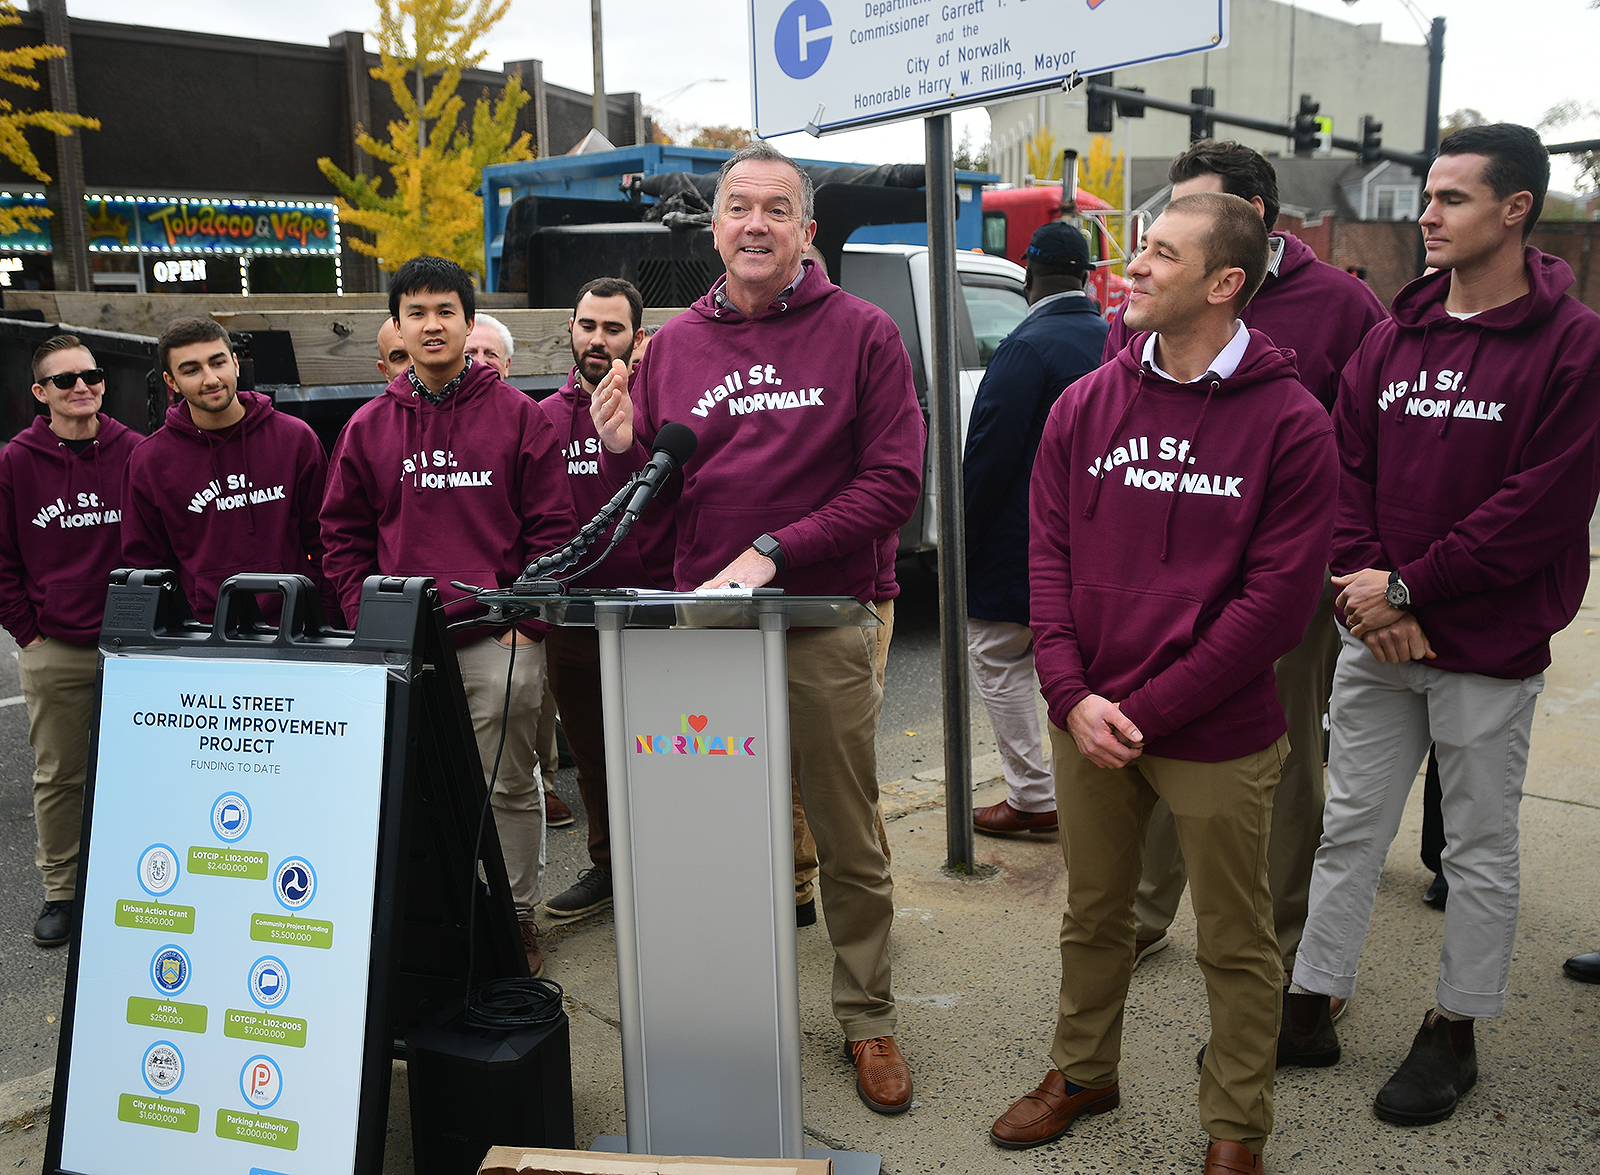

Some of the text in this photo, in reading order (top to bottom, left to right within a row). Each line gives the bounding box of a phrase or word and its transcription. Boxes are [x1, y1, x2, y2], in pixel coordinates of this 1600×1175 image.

[850, 0, 984, 45] Commissioner Garrett
[936, 24, 979, 44] and the
[907, 37, 1011, 75] City of Norwalk
[854, 83, 911, 109] Honorable
[918, 77, 951, 96] Harry
[960, 69, 973, 86] W.
[1034, 50, 1076, 71] Mayor
[147, 204, 255, 247] Tobacco
[153, 259, 207, 283] OPEN
[690, 363, 783, 418] Wall St.
[728, 387, 825, 416] NORWALK
[1123, 466, 1244, 498] NORWALK
[216, 485, 286, 511] NORWALK
[180, 693, 295, 712] WALL STREET
[133, 711, 348, 737] CORRIDOR IMPROVEMENT
[199, 736, 275, 753] PROJECT
[635, 734, 756, 756] NORWALK
[190, 759, 281, 775] FUNDING TO DATE
[193, 851, 219, 861] LOTCIP
[225, 853, 263, 864] L102-0004
[207, 861, 248, 873] $2,400,000
[122, 904, 188, 918] Urban Action Grant
[134, 915, 175, 927] $3,500,000
[255, 919, 329, 934] Community Project Funding
[270, 929, 312, 942] $5,500,000
[157, 1004, 177, 1014] ARPA
[150, 1013, 184, 1025] $250,000
[230, 1014, 257, 1024] LOTCIP
[263, 1019, 302, 1031] L102-0005
[244, 1026, 286, 1039] $7,000,000
[132, 1099, 186, 1115] City of Norwalk
[139, 1110, 178, 1124] $1,600,000
[226, 1115, 289, 1134] Parking Authority
[236, 1126, 278, 1141] $2,000,000
